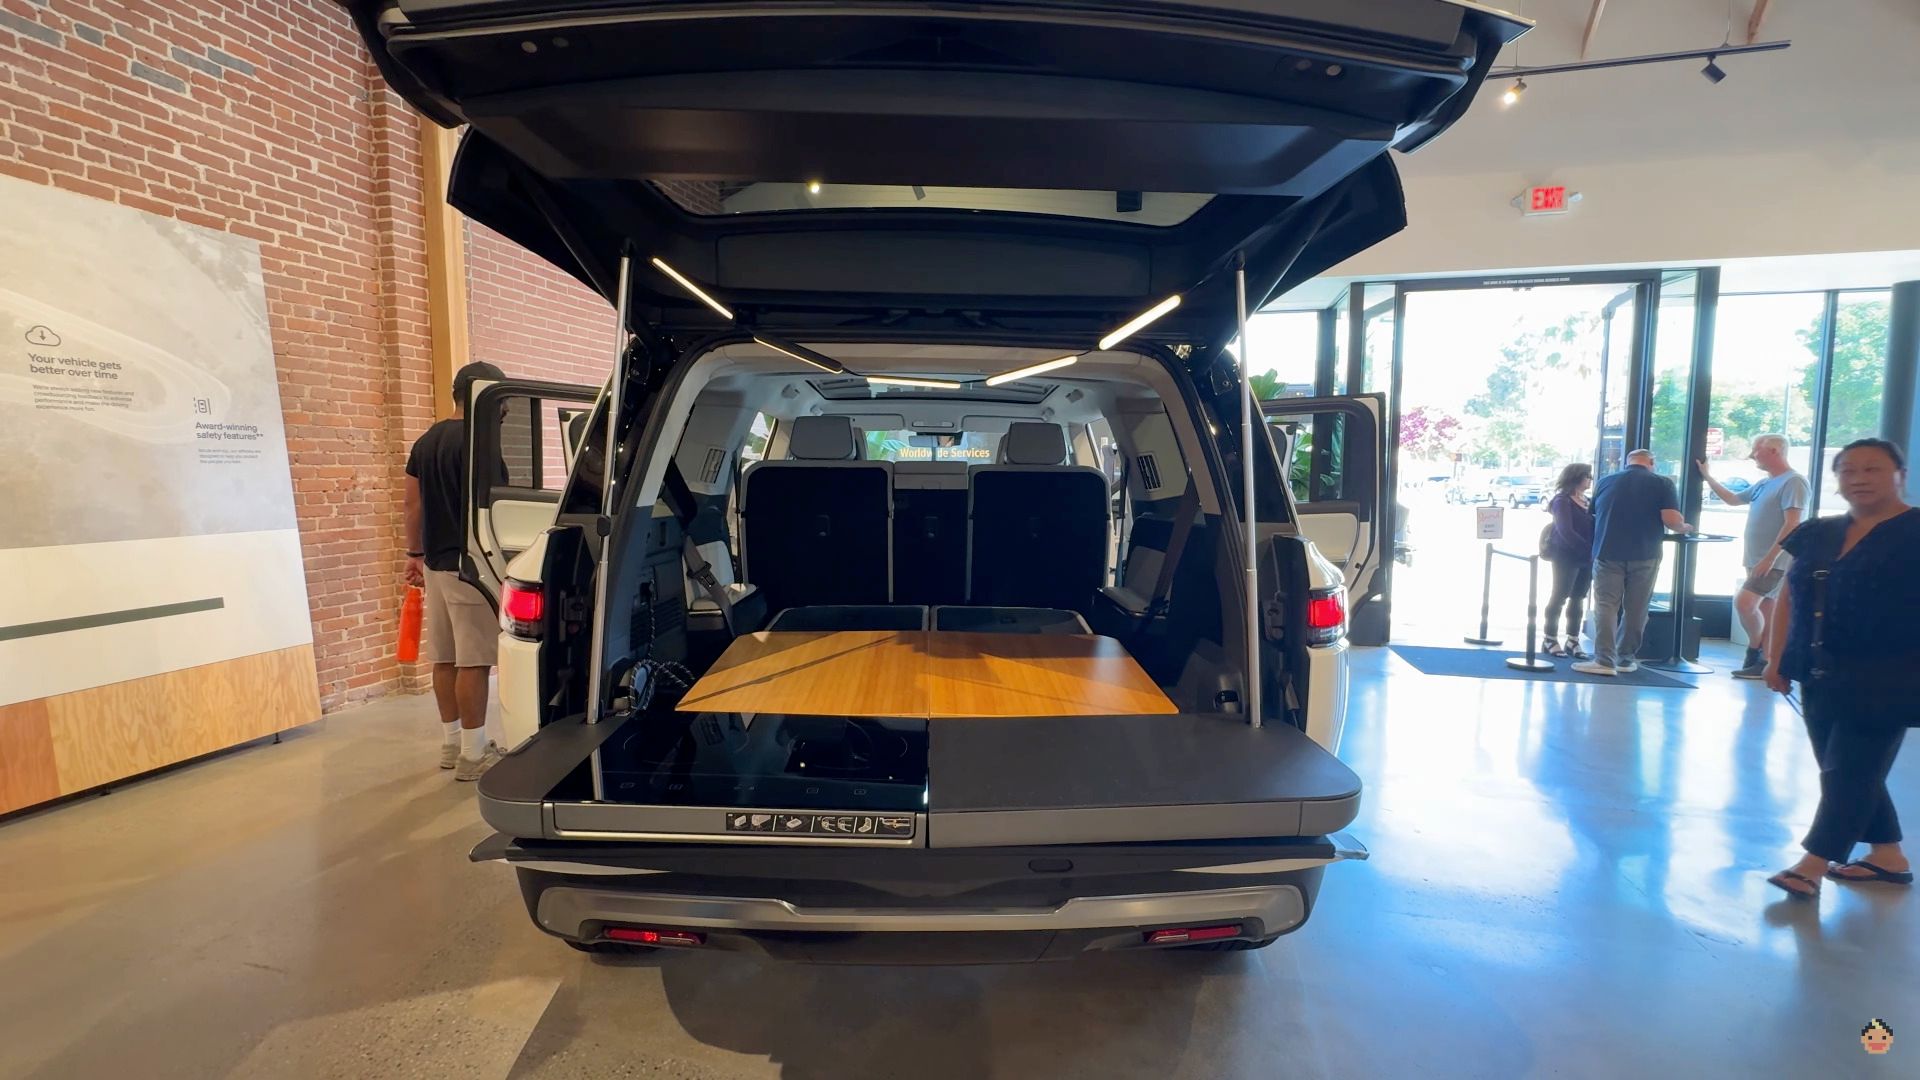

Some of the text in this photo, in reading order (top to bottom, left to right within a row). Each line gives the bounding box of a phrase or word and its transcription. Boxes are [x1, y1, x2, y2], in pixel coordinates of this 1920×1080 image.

[1532, 186, 1566, 209] EXIT
[28, 352, 122, 371] Your vehicle gets
[30, 364, 118, 380] better over time
[195, 421, 258, 433] Award-winning
[196, 432, 222, 441] safety
[951, 447, 991, 458] Services
